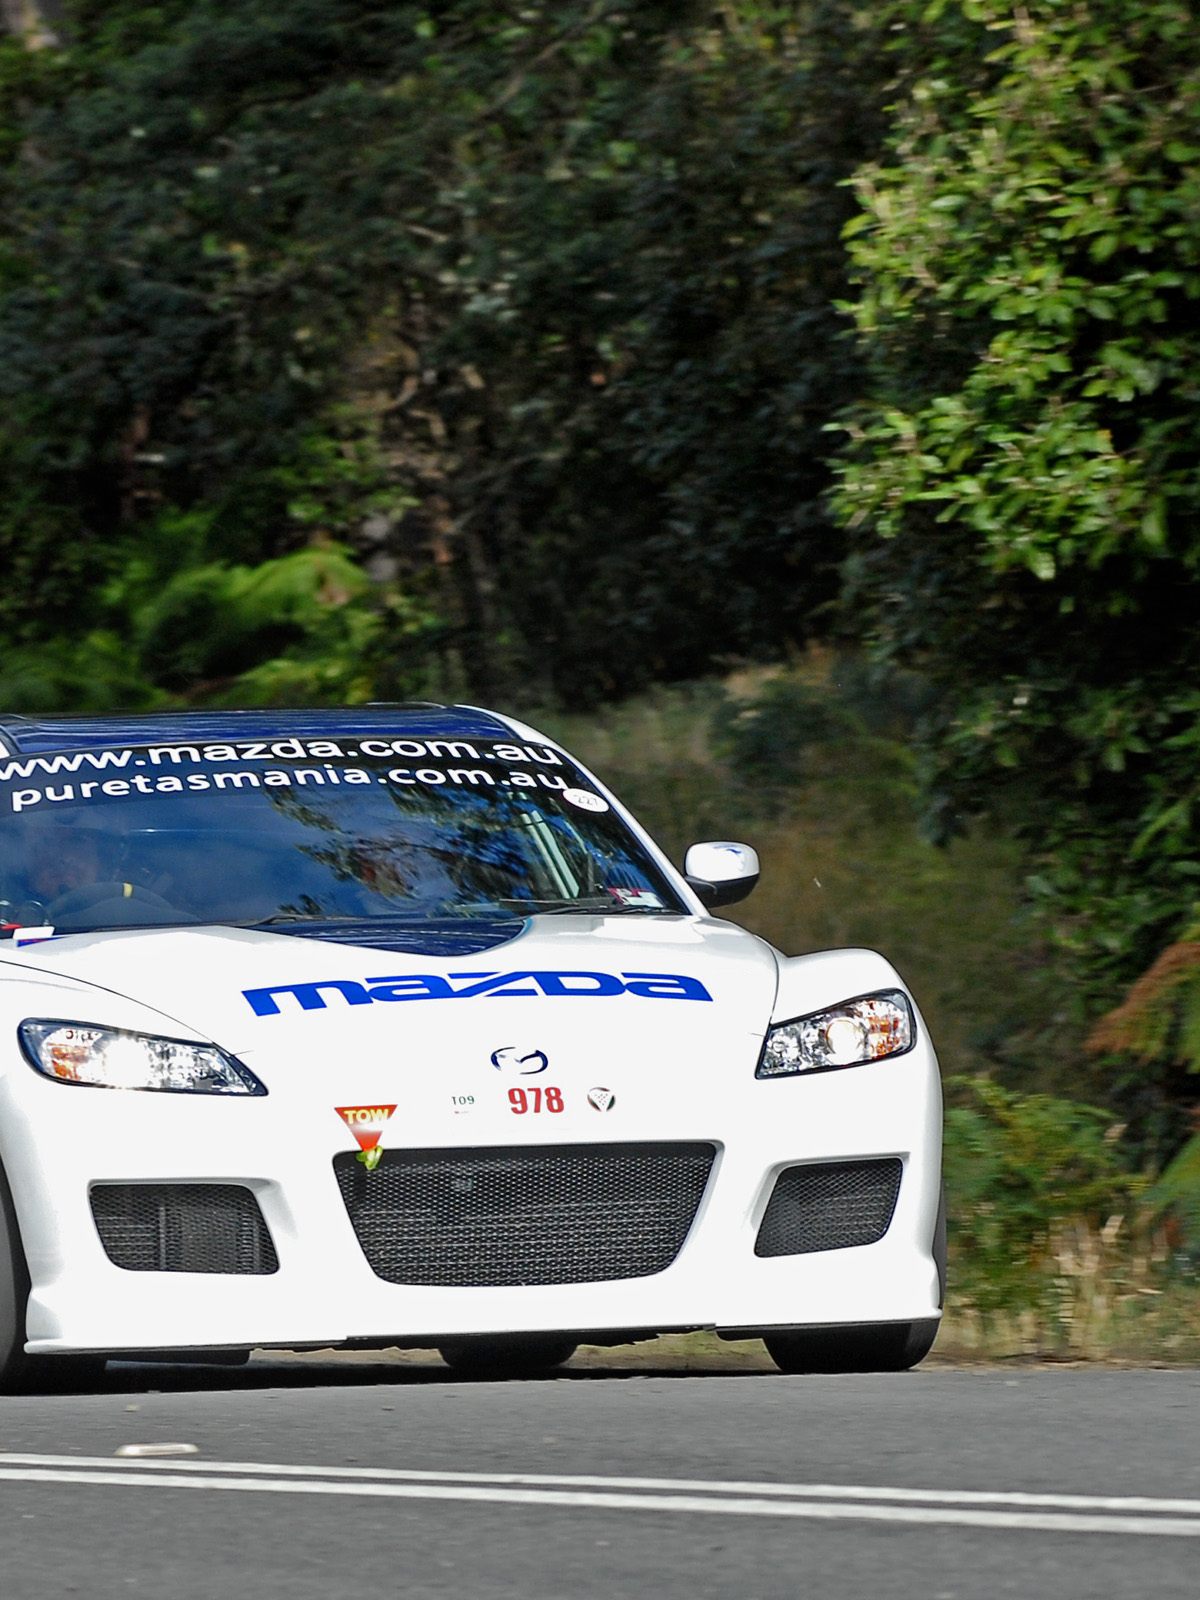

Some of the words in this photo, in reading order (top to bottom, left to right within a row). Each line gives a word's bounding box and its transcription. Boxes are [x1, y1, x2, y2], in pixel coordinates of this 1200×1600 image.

[11, 763, 569, 812] puretasmania.com.au
[508, 1086, 564, 1115] 978
[343, 1108, 389, 1125] TOW
